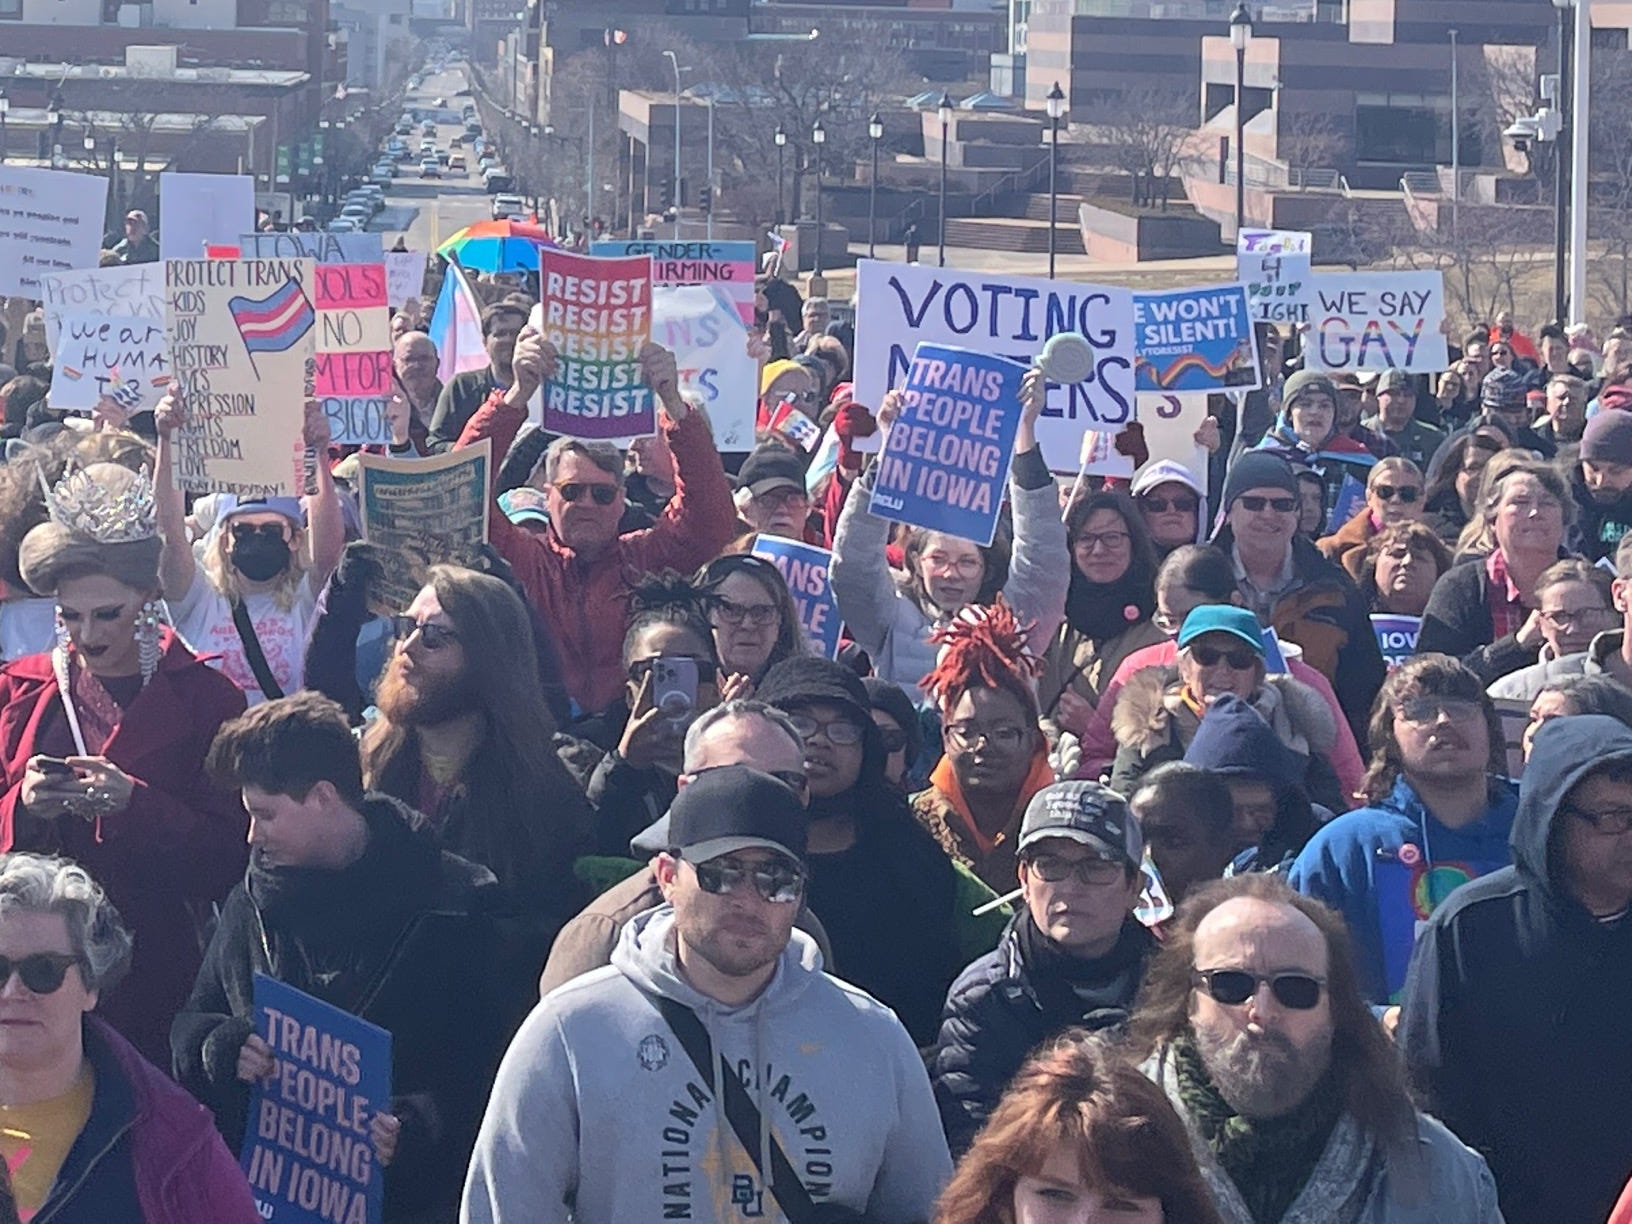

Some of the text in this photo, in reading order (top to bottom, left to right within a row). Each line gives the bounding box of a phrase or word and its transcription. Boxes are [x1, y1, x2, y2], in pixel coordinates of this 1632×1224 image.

[252, 234, 345, 262] IOWA
[625, 243, 723, 260] GENDER-
[47, 268, 151, 305] Protect
[166, 260, 305, 287] PROTECT TRANS
[548, 272, 647, 306] RESIST
[548, 301, 648, 334] RESIST
[888, 275, 1117, 349] VOTING
[1150, 292, 1241, 323] WON'T
[1318, 289, 1432, 317] WE SAY
[119, 325, 163, 345] ar
[324, 310, 363, 347] NO
[1144, 317, 1238, 346] SILENT!
[1319, 316, 1425, 369] GAY
[82, 345, 169, 374] HUMA
[549, 331, 648, 363] RESIST
[556, 359, 644, 391] RESIST
[911, 357, 1005, 402] TRANS
[182, 393, 256, 417] XPRESSION
[549, 385, 649, 419] RESIST
[900, 390, 1005, 441] PEOPLE
[888, 423, 1002, 478] BELONG
[877, 455, 992, 515] IN IOWA
[263, 1006, 362, 1086] TRANS
[263, 1057, 369, 1136] PEOPLE
[258, 1097, 371, 1186] BELONG
[661, 1081, 713, 1220] NATIONA
[247, 1144, 368, 1224] IN IOWA
